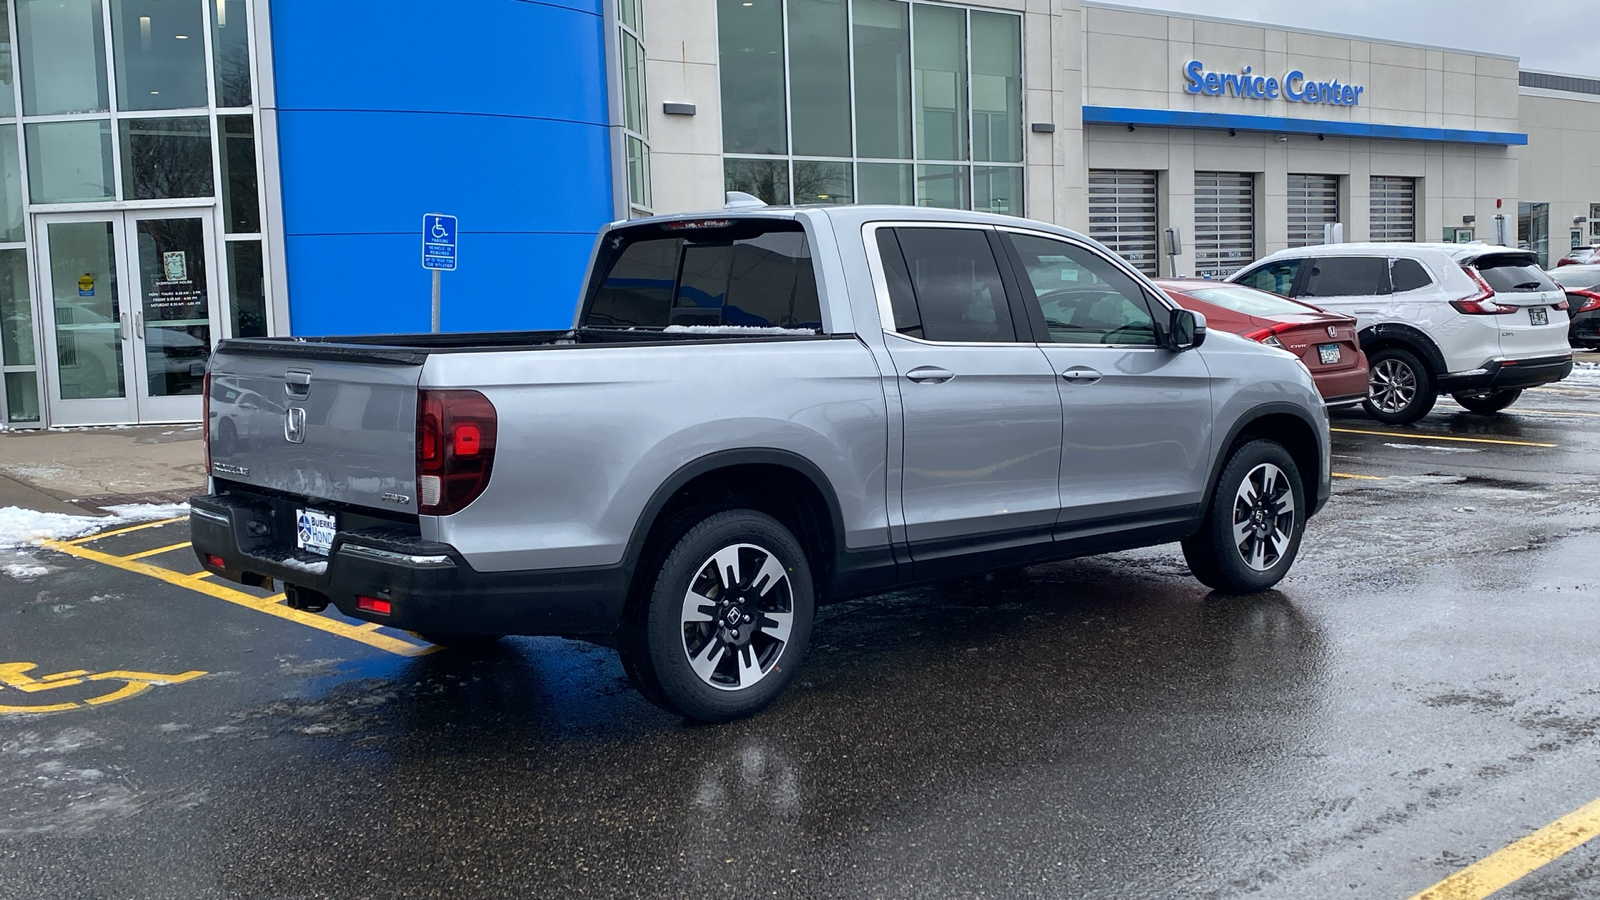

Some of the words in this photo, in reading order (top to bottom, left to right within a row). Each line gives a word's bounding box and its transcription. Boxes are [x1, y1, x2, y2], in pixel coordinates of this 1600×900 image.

[1183, 60, 1279, 100] Service
[1283, 70, 1364, 106] Center
[311, 516, 337, 529] BUERKLE
[312, 526, 334, 545] HOND
